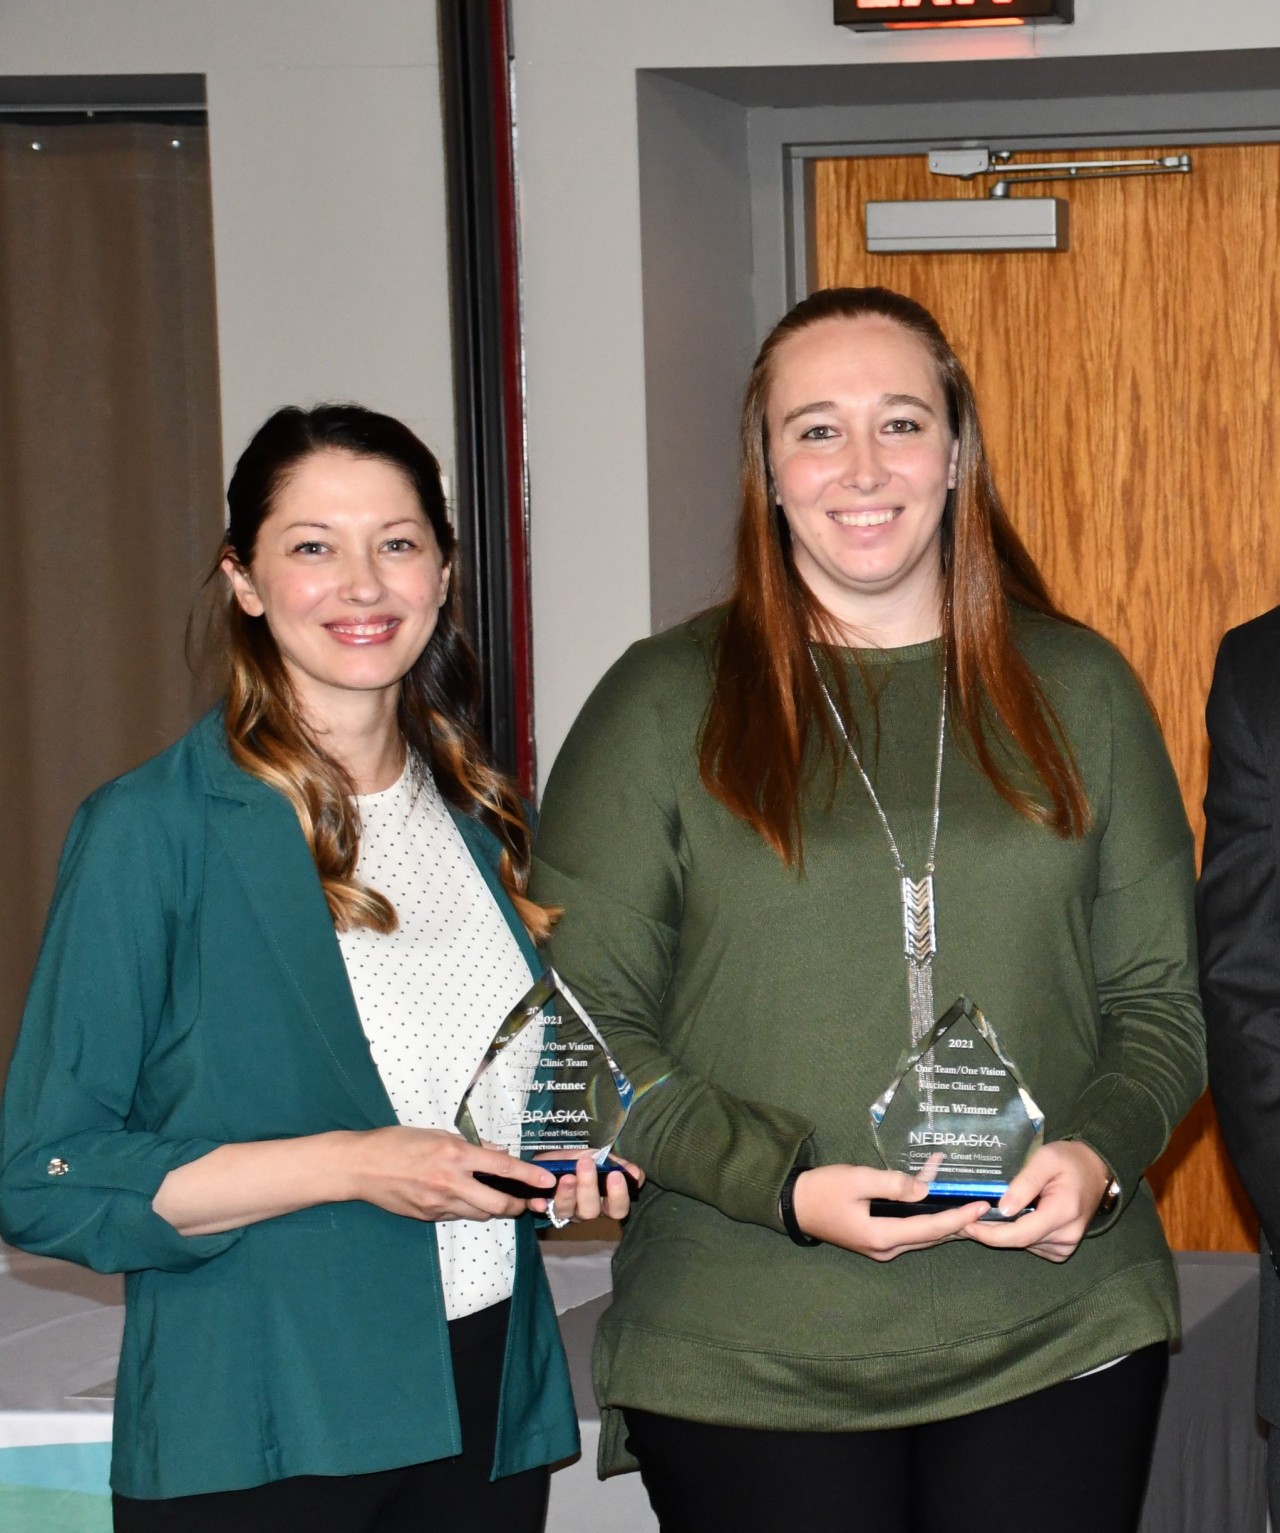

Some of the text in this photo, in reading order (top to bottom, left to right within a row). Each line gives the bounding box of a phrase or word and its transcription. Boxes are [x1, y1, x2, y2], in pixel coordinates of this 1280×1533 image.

[568, 1042, 594, 1051] Vision
[948, 1039, 974, 1048] 2021
[540, 1058, 565, 1067] Clinic
[566, 1058, 588, 1067] Team
[914, 1063, 1006, 1077] One Team/One Vision
[546, 1080, 587, 1090] Kennec
[951, 1081, 976, 1091] Clinic
[977, 1082, 1000, 1092] Team
[919, 1102, 998, 1115] Sierra Wimmer
[538, 1129, 560, 1137] Great
[909, 1131, 1002, 1148] NEBRASKA
[909, 1150, 931, 1158] Good
[950, 1152, 973, 1160] Great
